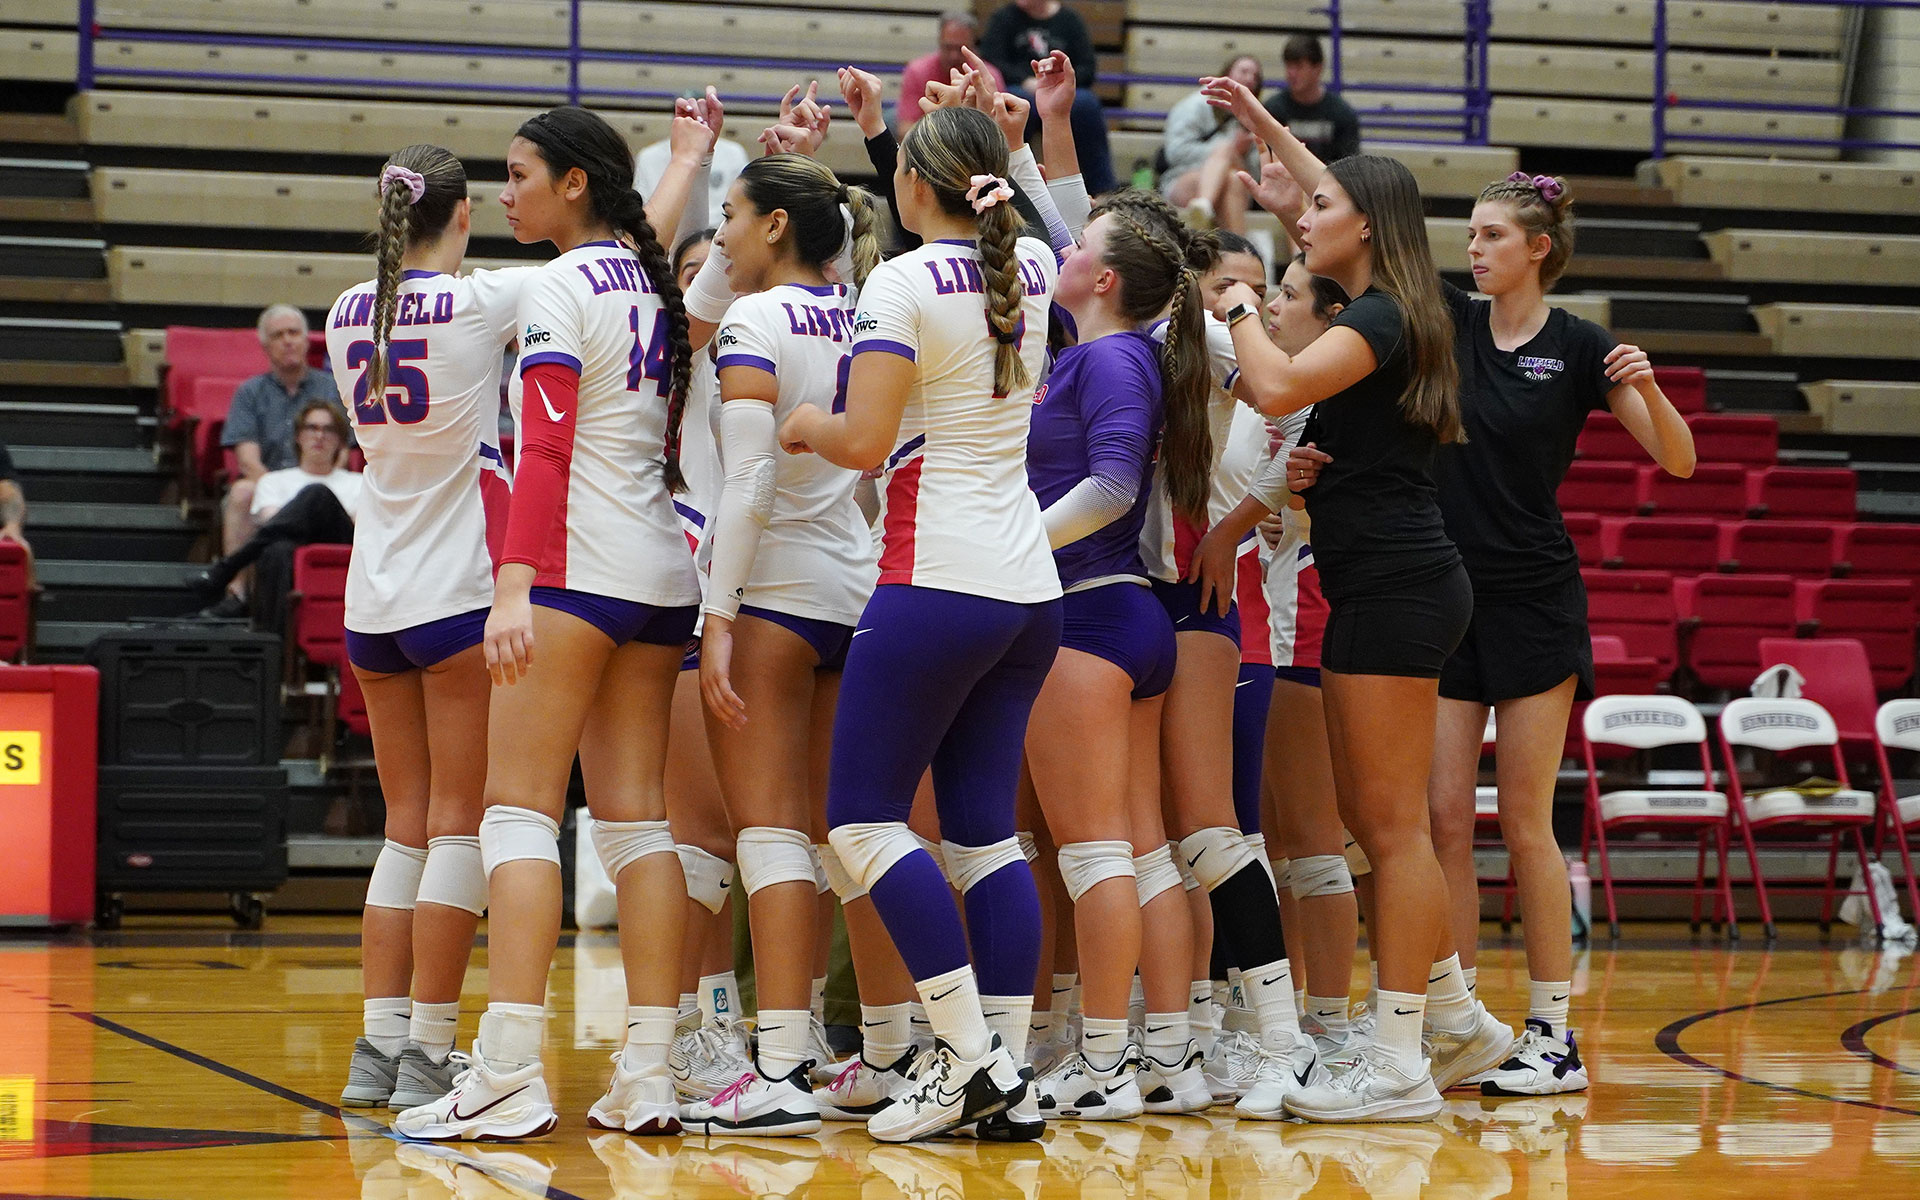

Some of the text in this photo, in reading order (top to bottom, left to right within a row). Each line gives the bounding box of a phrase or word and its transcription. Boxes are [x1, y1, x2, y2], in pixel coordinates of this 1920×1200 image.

[333, 290, 454, 330] LINELD
[524, 331, 552, 348] NWC
[854, 319, 878, 335] NWC
[625, 305, 674, 398] 14
[1517, 355, 1565, 372] LINFIELD
[346, 337, 430, 426] 25
[4, 743, 24, 771] S
